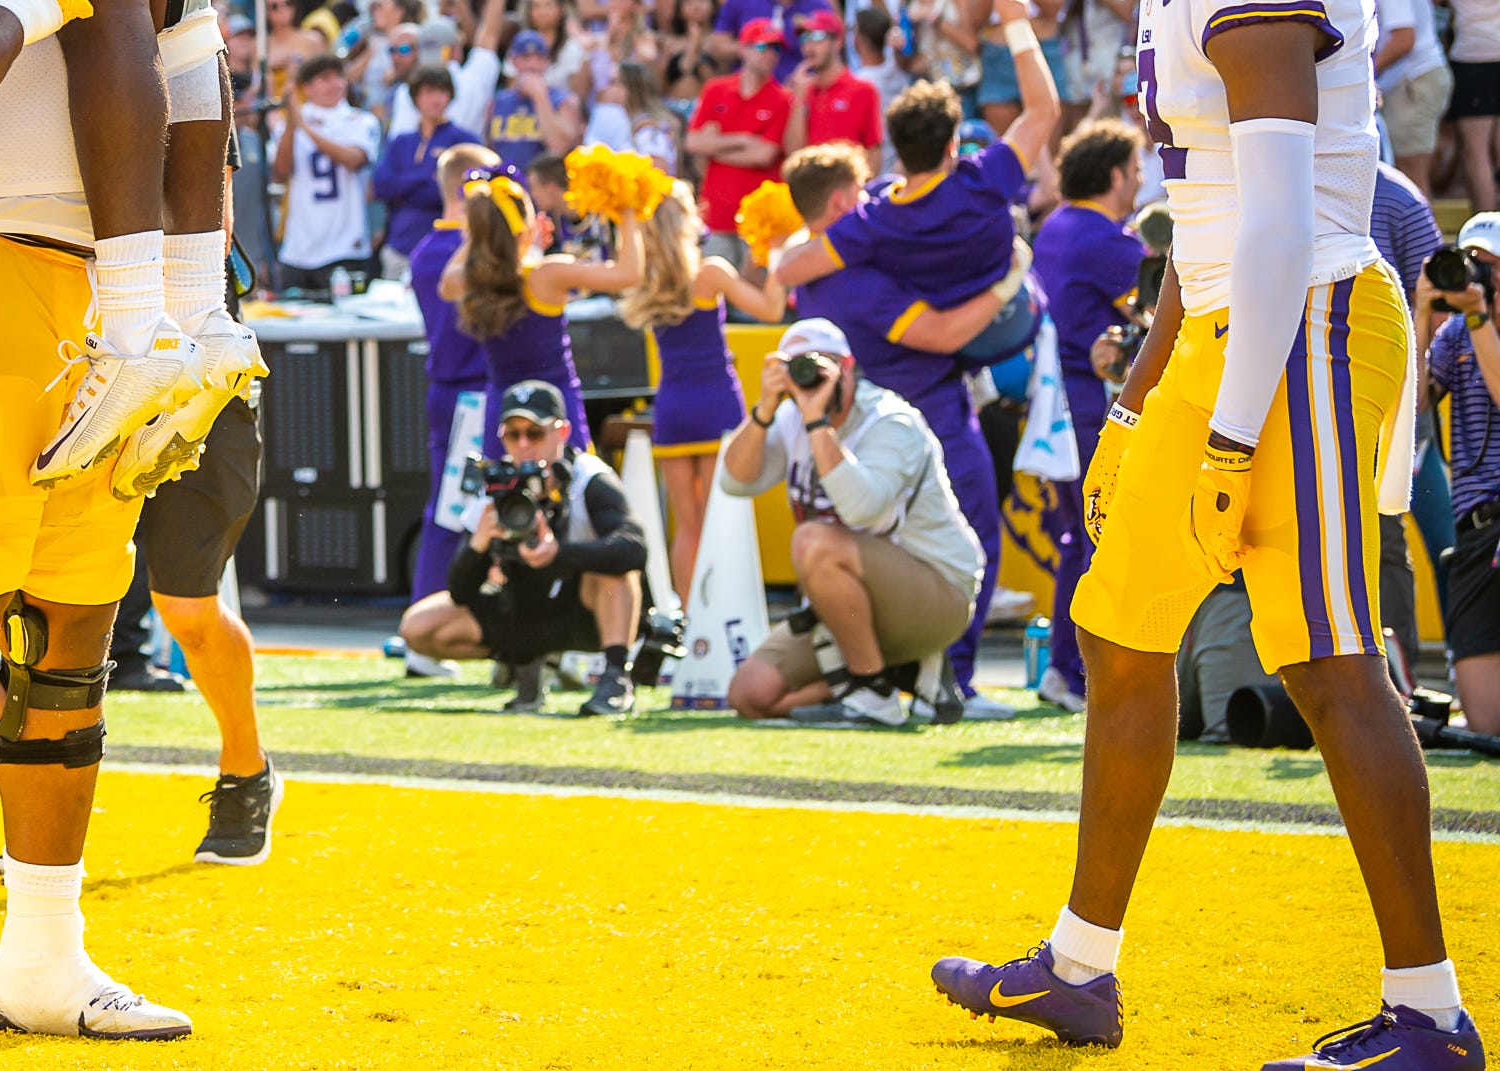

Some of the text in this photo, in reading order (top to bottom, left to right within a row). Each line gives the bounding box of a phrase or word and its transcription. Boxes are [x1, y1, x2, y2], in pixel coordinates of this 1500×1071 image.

[309, 151, 339, 200] 9
[85, 336, 98, 350] LSU
[153, 338, 181, 351] NIKE
